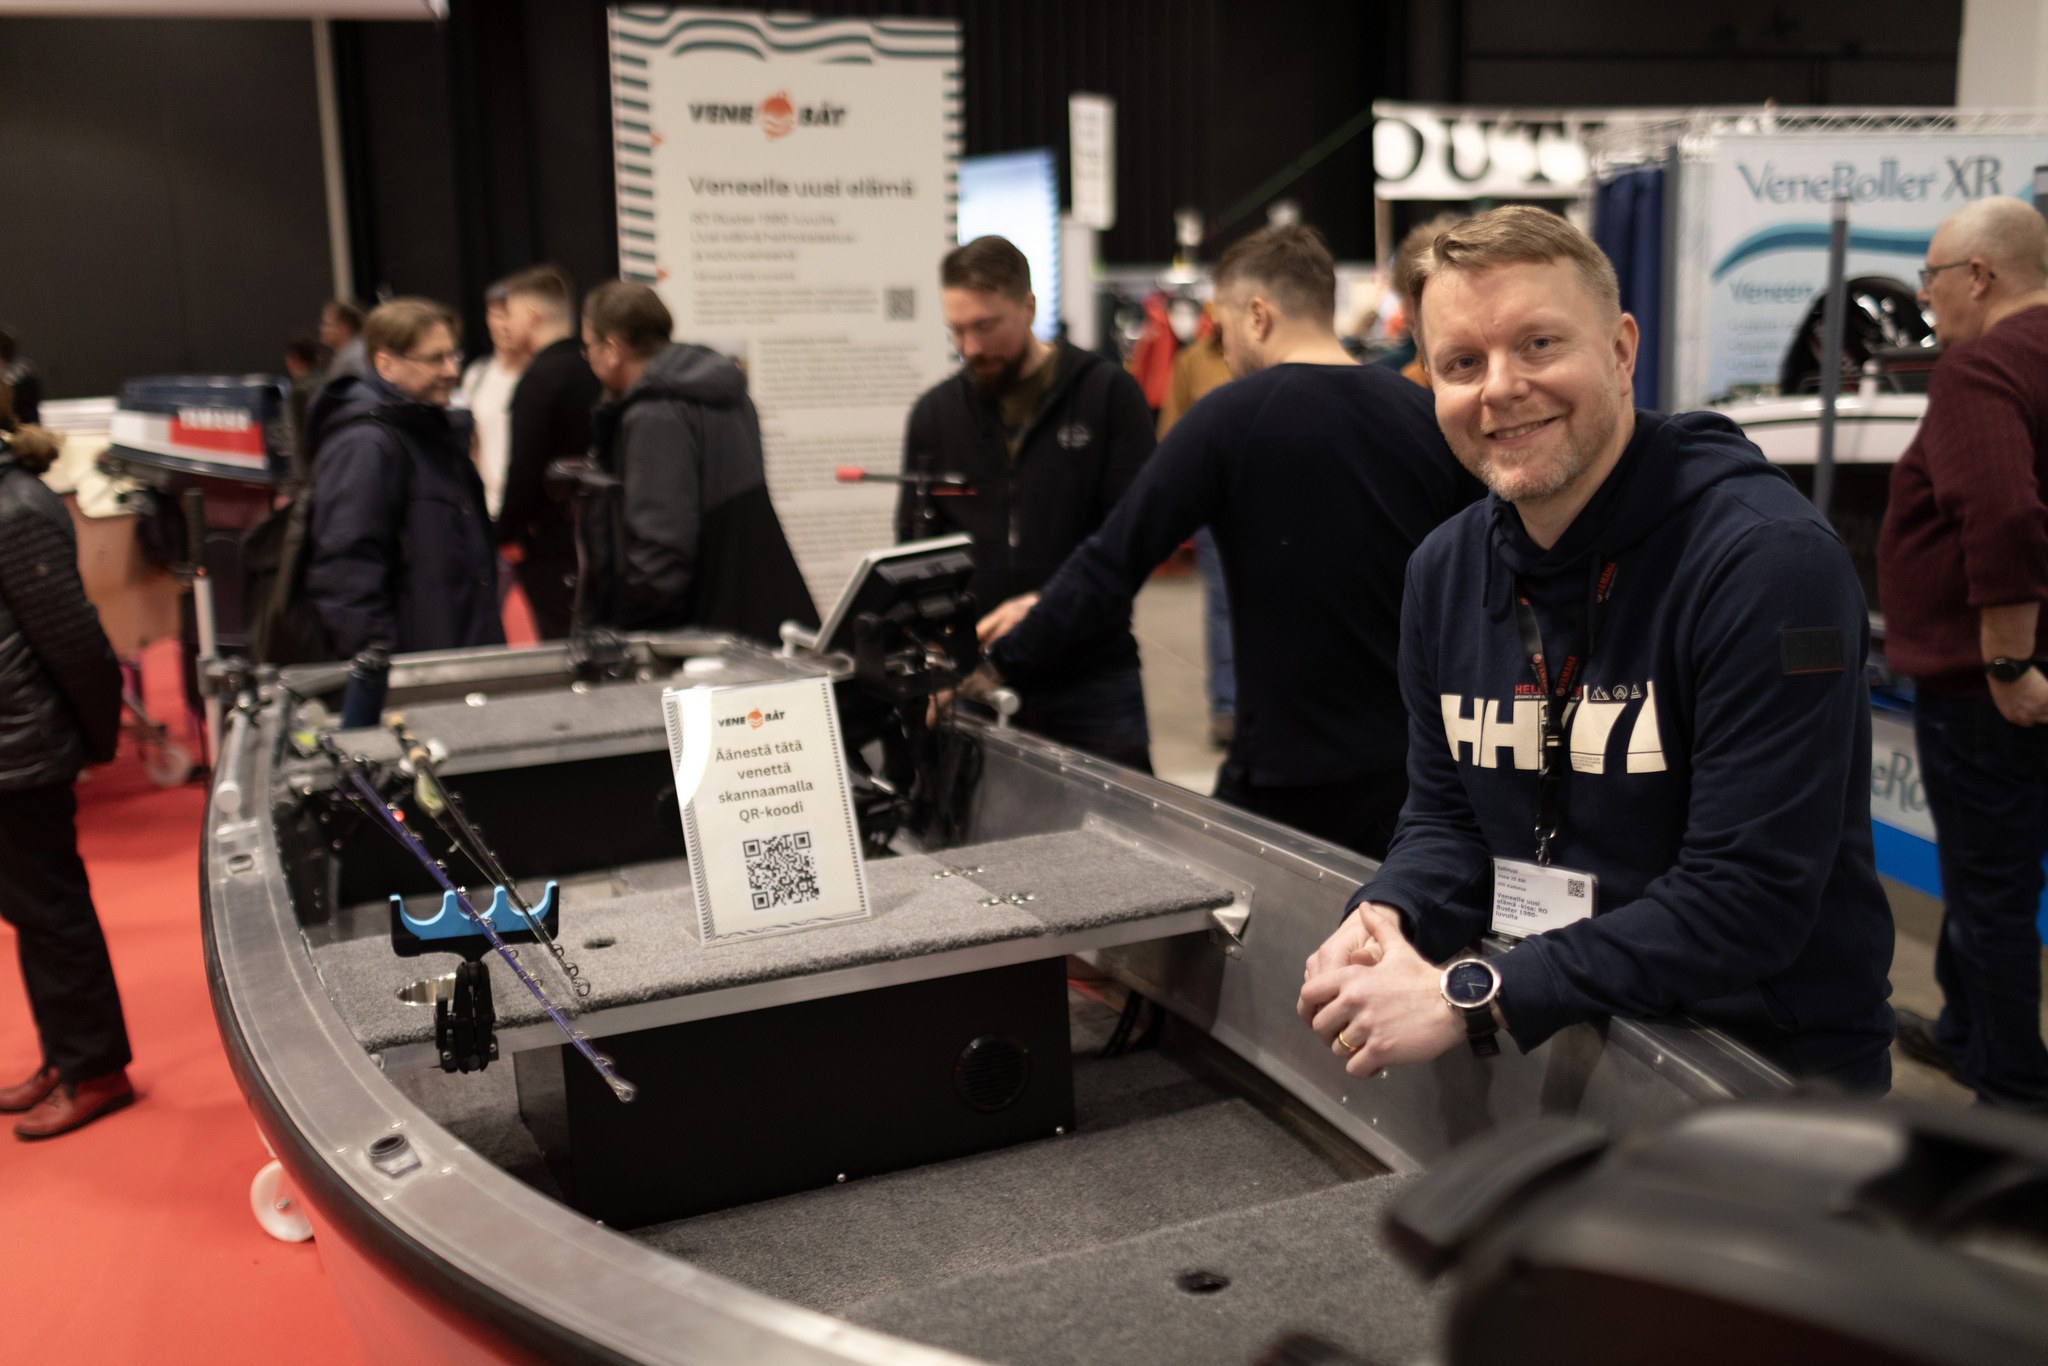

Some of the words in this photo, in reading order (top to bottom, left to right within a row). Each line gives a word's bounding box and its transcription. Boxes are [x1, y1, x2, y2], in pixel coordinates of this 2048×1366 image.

[689, 176, 789, 198] Veneelle
[794, 177, 841, 198] uusi
[1945, 155, 2002, 198] XR
[1514, 684, 1544, 694] HELL
[718, 716, 746, 728] VENE
[764, 710, 786, 722] BÅT
[715, 743, 773, 762] Äänestä
[775, 740, 804, 754] tätä
[737, 763, 792, 780] venettä
[718, 780, 814, 804] skannaamalla
[738, 802, 804, 823] QR-koodi
